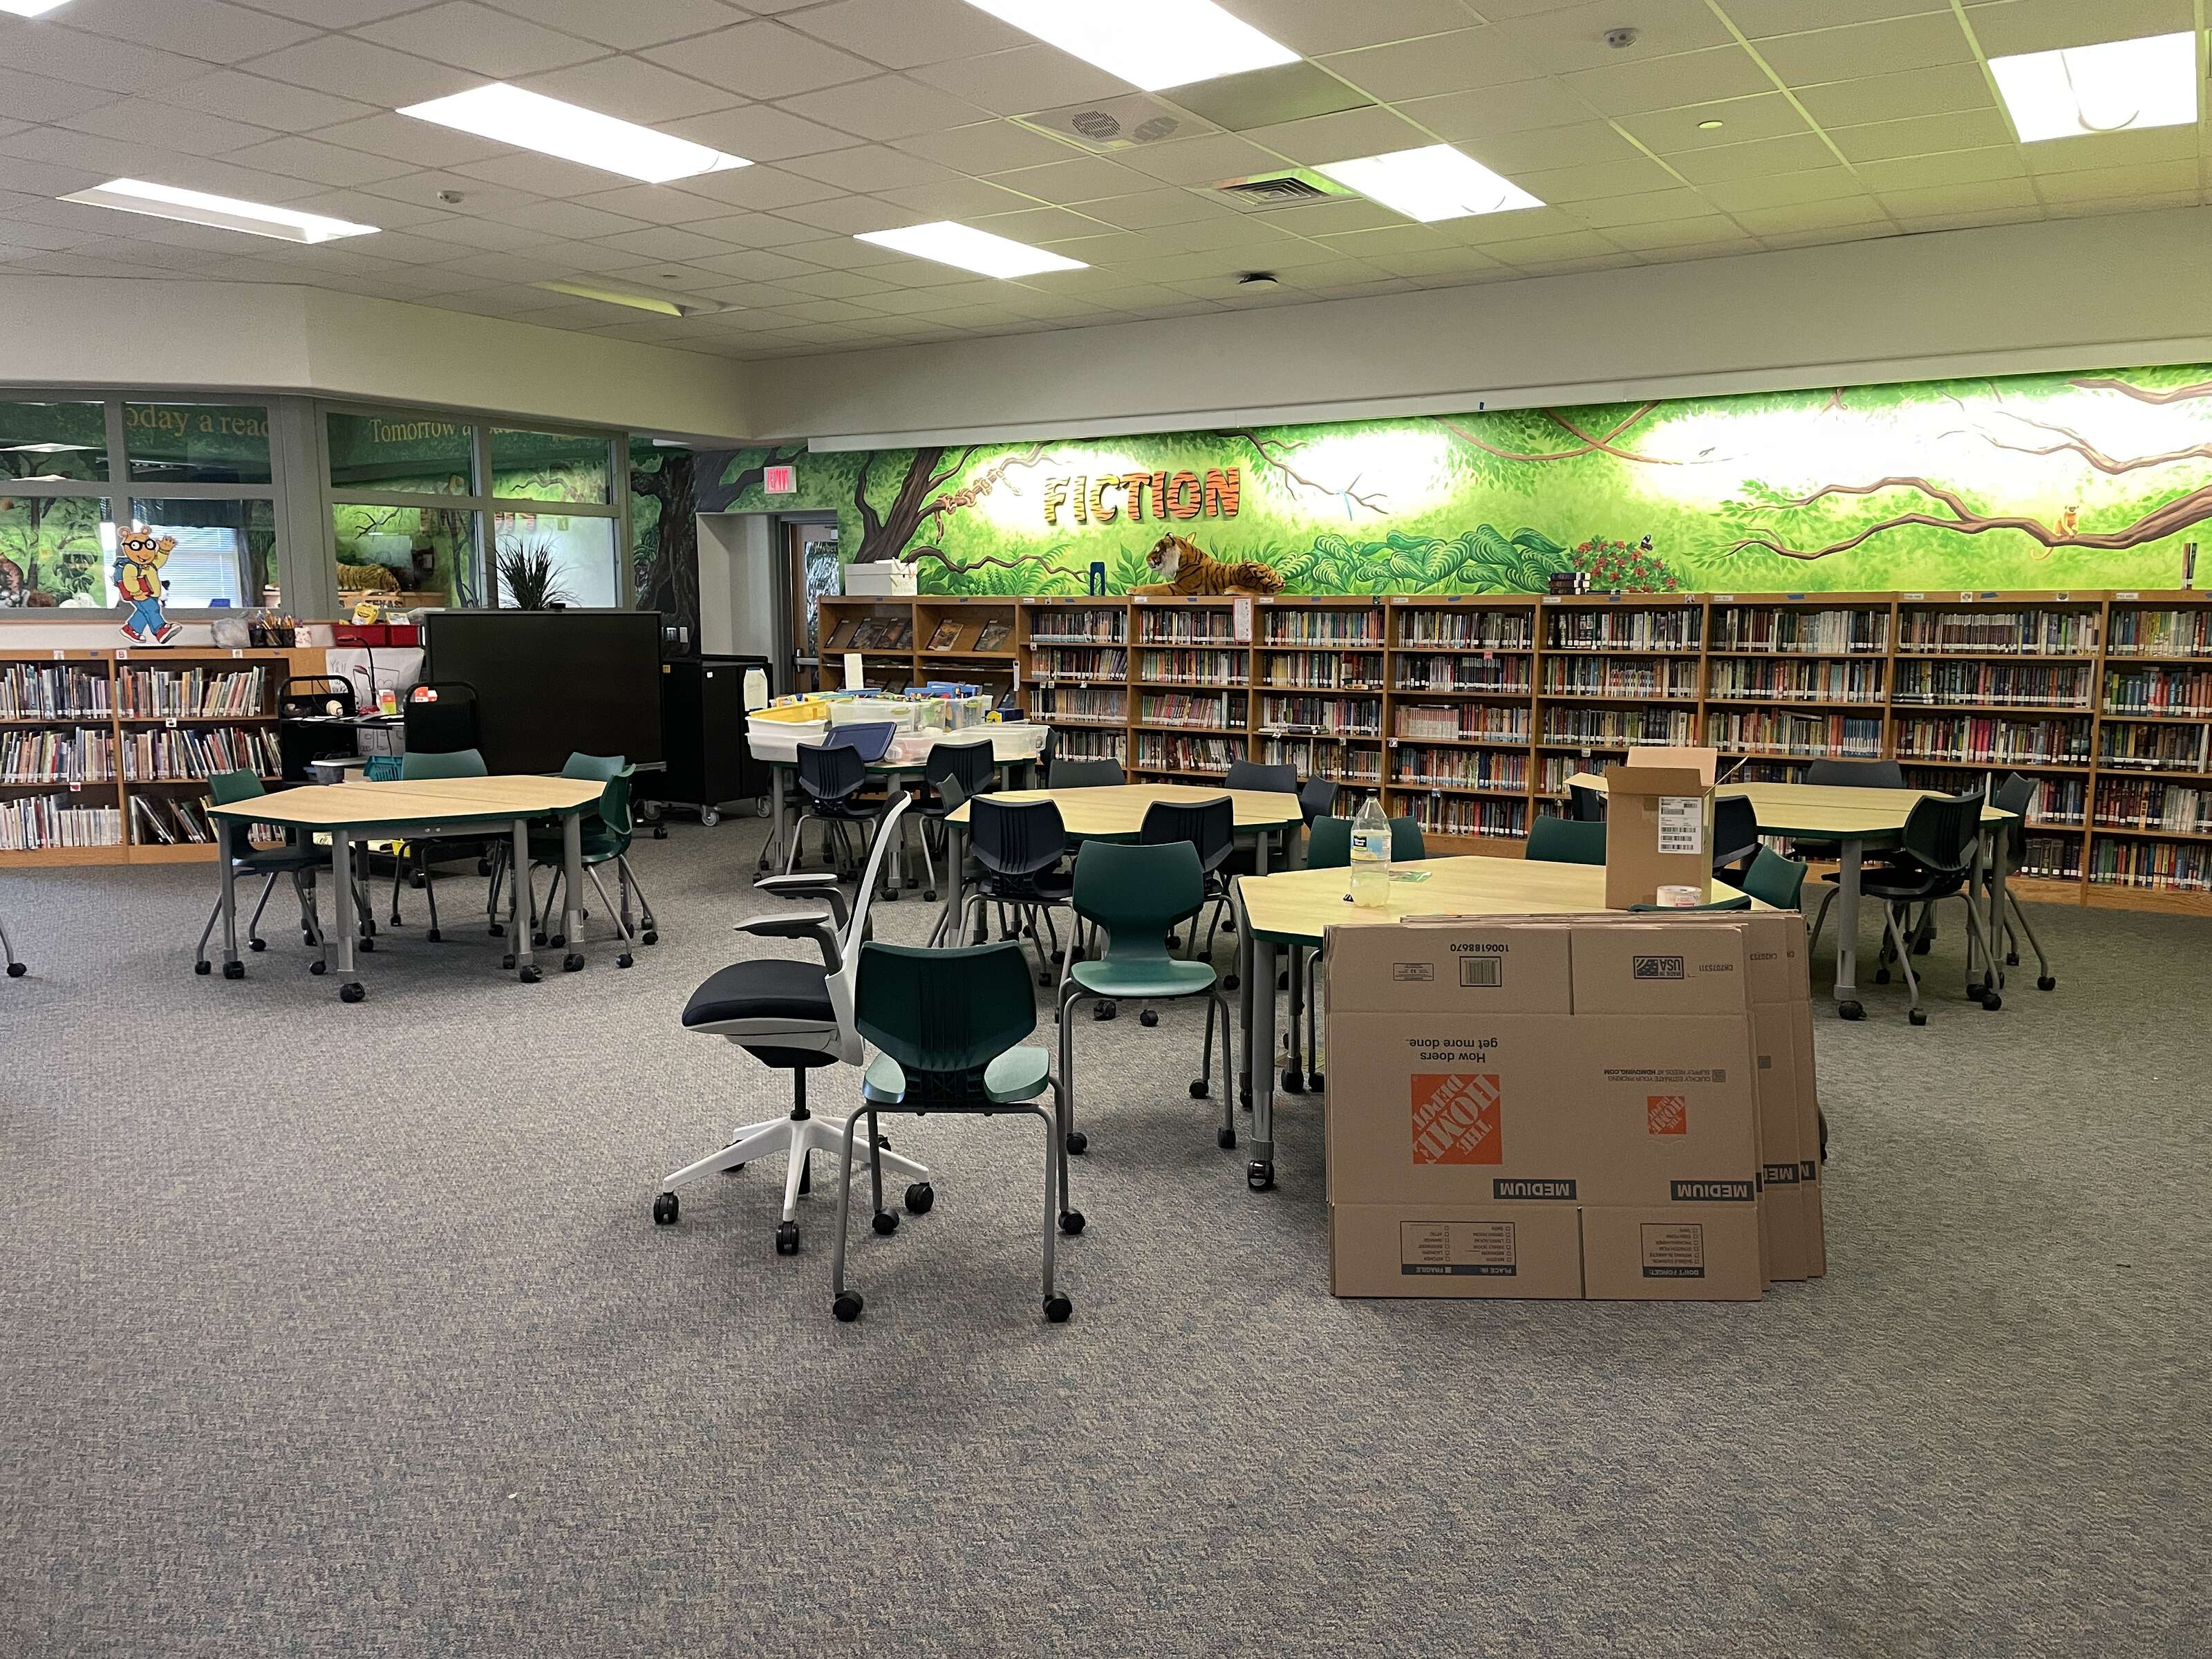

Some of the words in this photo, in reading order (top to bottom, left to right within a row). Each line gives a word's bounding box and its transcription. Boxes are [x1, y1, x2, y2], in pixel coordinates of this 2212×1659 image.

[200, 415, 215, 432] a
[370, 419, 455, 443] Tomorrow
[768, 469, 788, 491] EXIT
[1044, 467, 1240, 523] FICTION
[118, 650, 125, 659] B
[1450, 944, 1509, 952] 1006188670
[1660, 959, 1681, 971] USA
[1409, 1039, 1440, 1049] done
[1443, 1039, 1474, 1047] more
[1479, 1038, 1498, 1049] get
[1420, 1052, 1455, 1062] doers
[1459, 1052, 1485, 1063] How
[1412, 1074, 1465, 1132] DEPOT
[1413, 1074, 1501, 1166] HOME
[1457, 1120, 1492, 1155] THE
[1500, 1183, 1570, 1197] MEDIUM
[1678, 1184, 1747, 1198] MEDIUM
